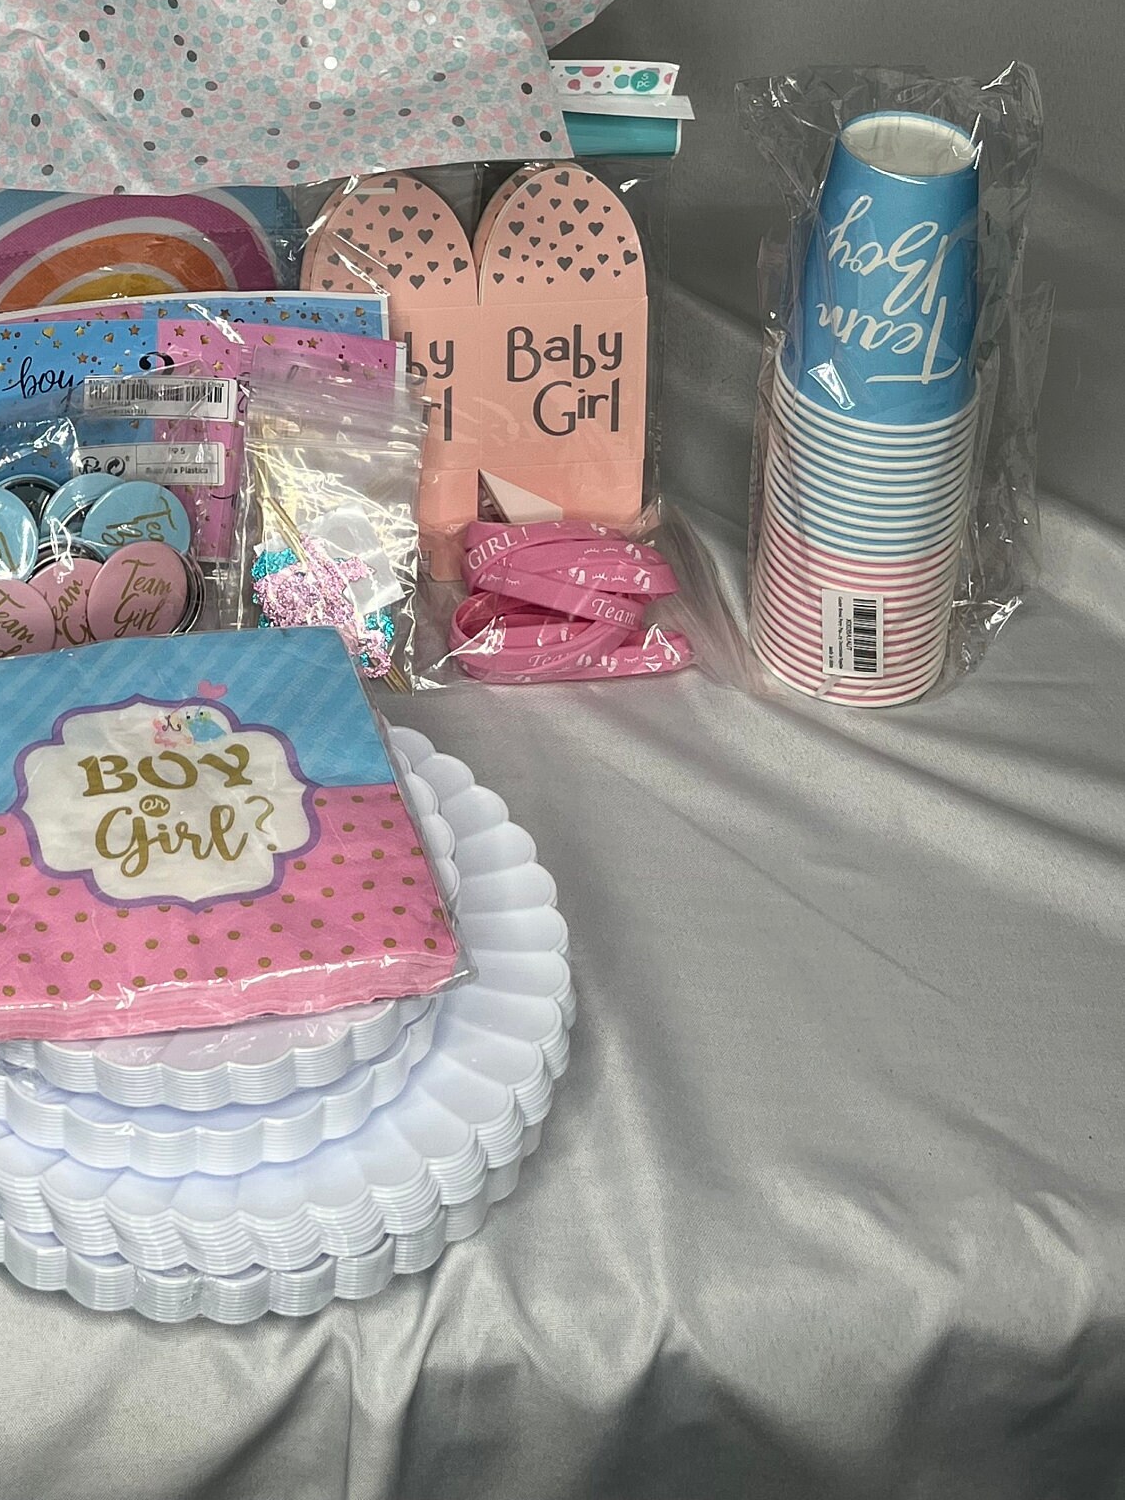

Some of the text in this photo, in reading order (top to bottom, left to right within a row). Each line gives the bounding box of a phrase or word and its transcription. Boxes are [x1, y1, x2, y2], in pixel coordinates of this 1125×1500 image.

[827, 195, 948, 316] Boy
[403, 331, 454, 386] by
[506, 324, 623, 383] Baby
[816, 296, 961, 384] Team
[532, 377, 620, 437] Girl
[467, 531, 518, 571] GIRL
[51, 580, 84, 621] eam
[122, 559, 172, 600] Team
[114, 594, 166, 637] Girl
[591, 598, 636, 625] Team
[528, 652, 570, 668] Tea
[77, 744, 253, 797] BOY
[141, 798, 169, 811] or
[95, 795, 277, 878] Girl?
